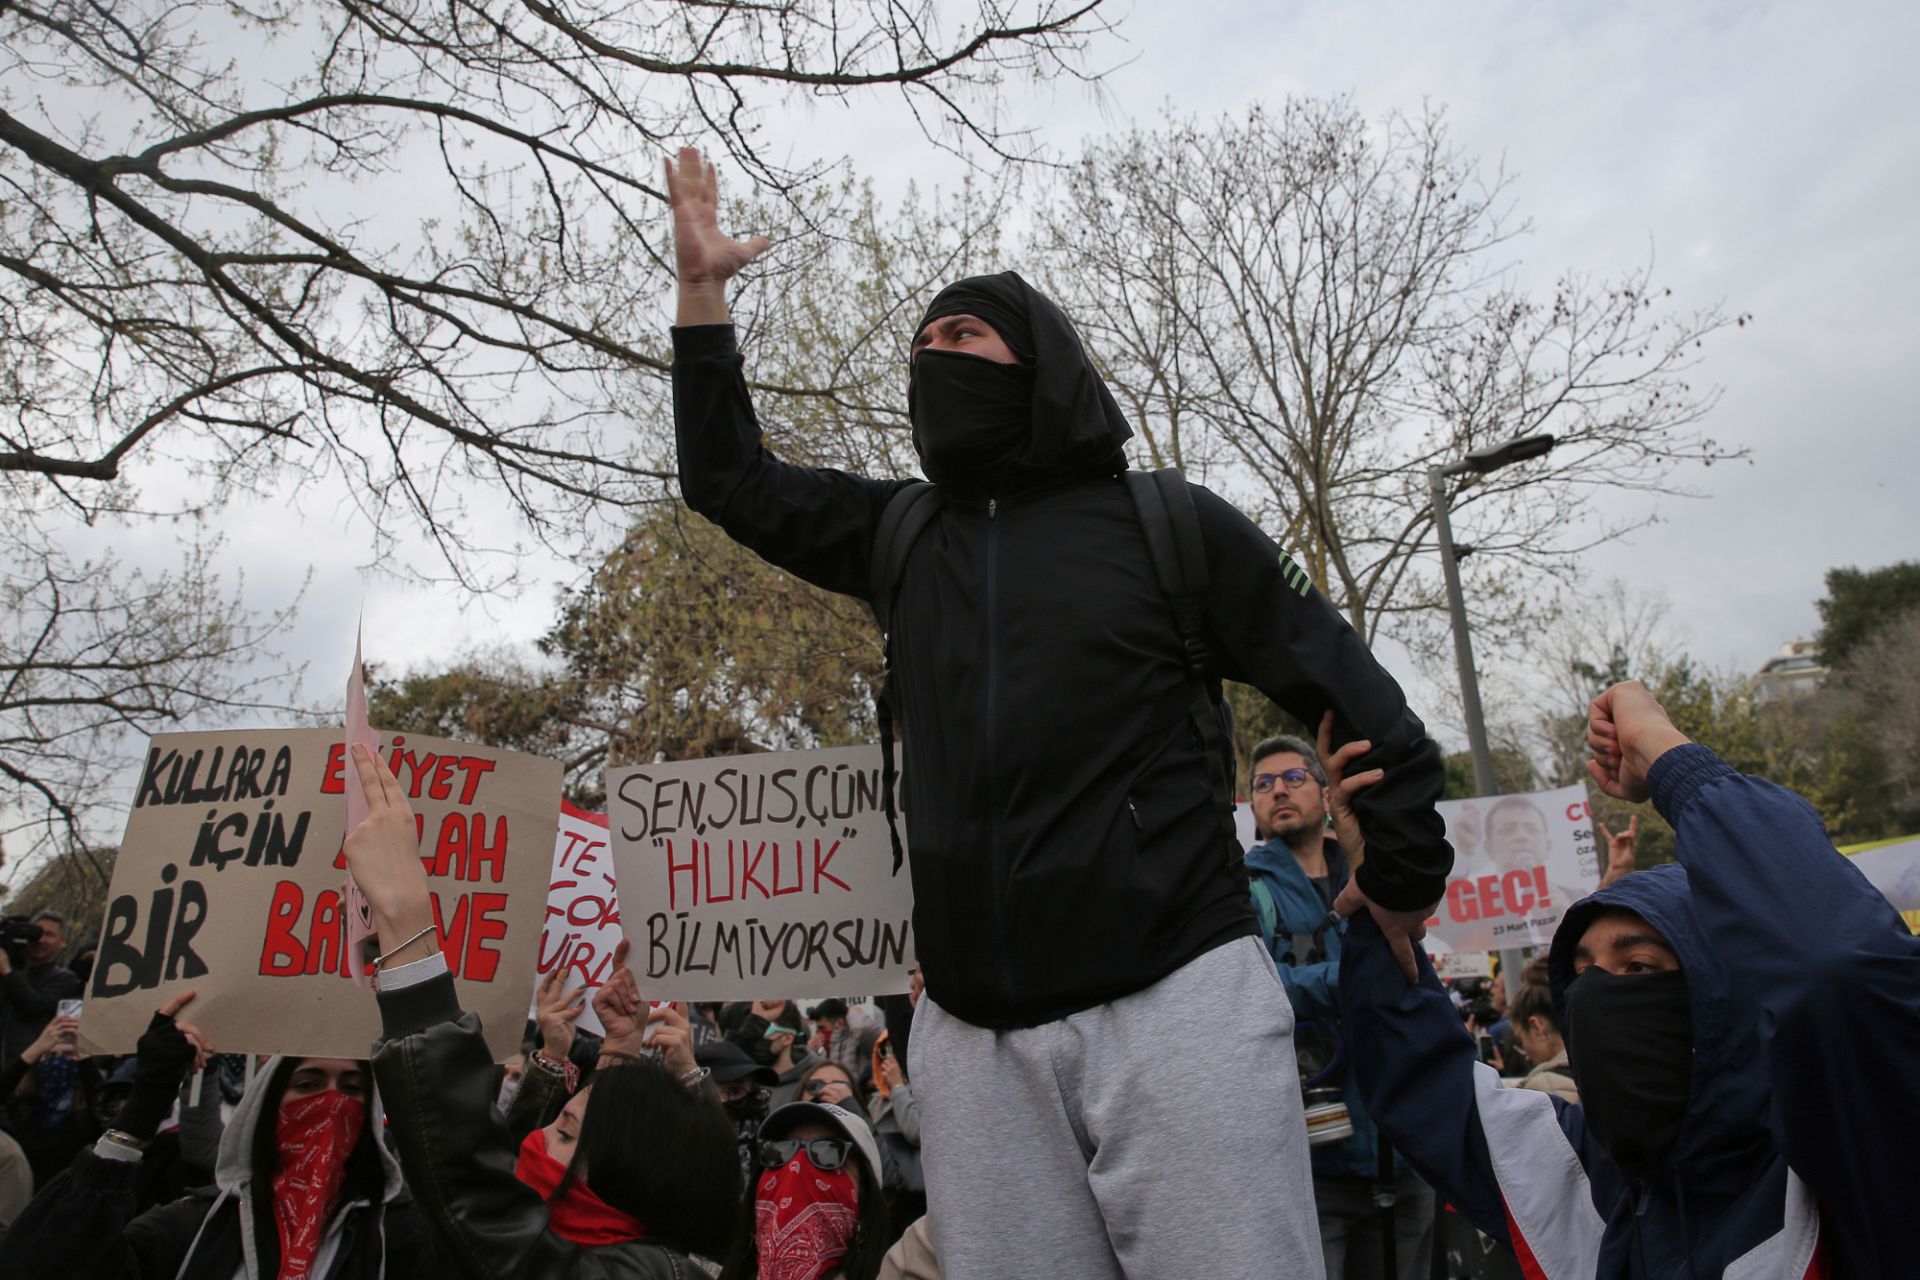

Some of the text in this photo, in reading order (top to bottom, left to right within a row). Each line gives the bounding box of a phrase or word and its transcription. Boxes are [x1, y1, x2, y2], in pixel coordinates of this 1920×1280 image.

[136, 736, 496, 808] KULLARA EİYET
[189, 799, 311, 871] İÇİN
[1447, 865, 1552, 924] GEÇ!
[1493, 926, 1505, 936] 23
[1506, 921, 1528, 933] Mart
[92, 864, 209, 999] BİR
